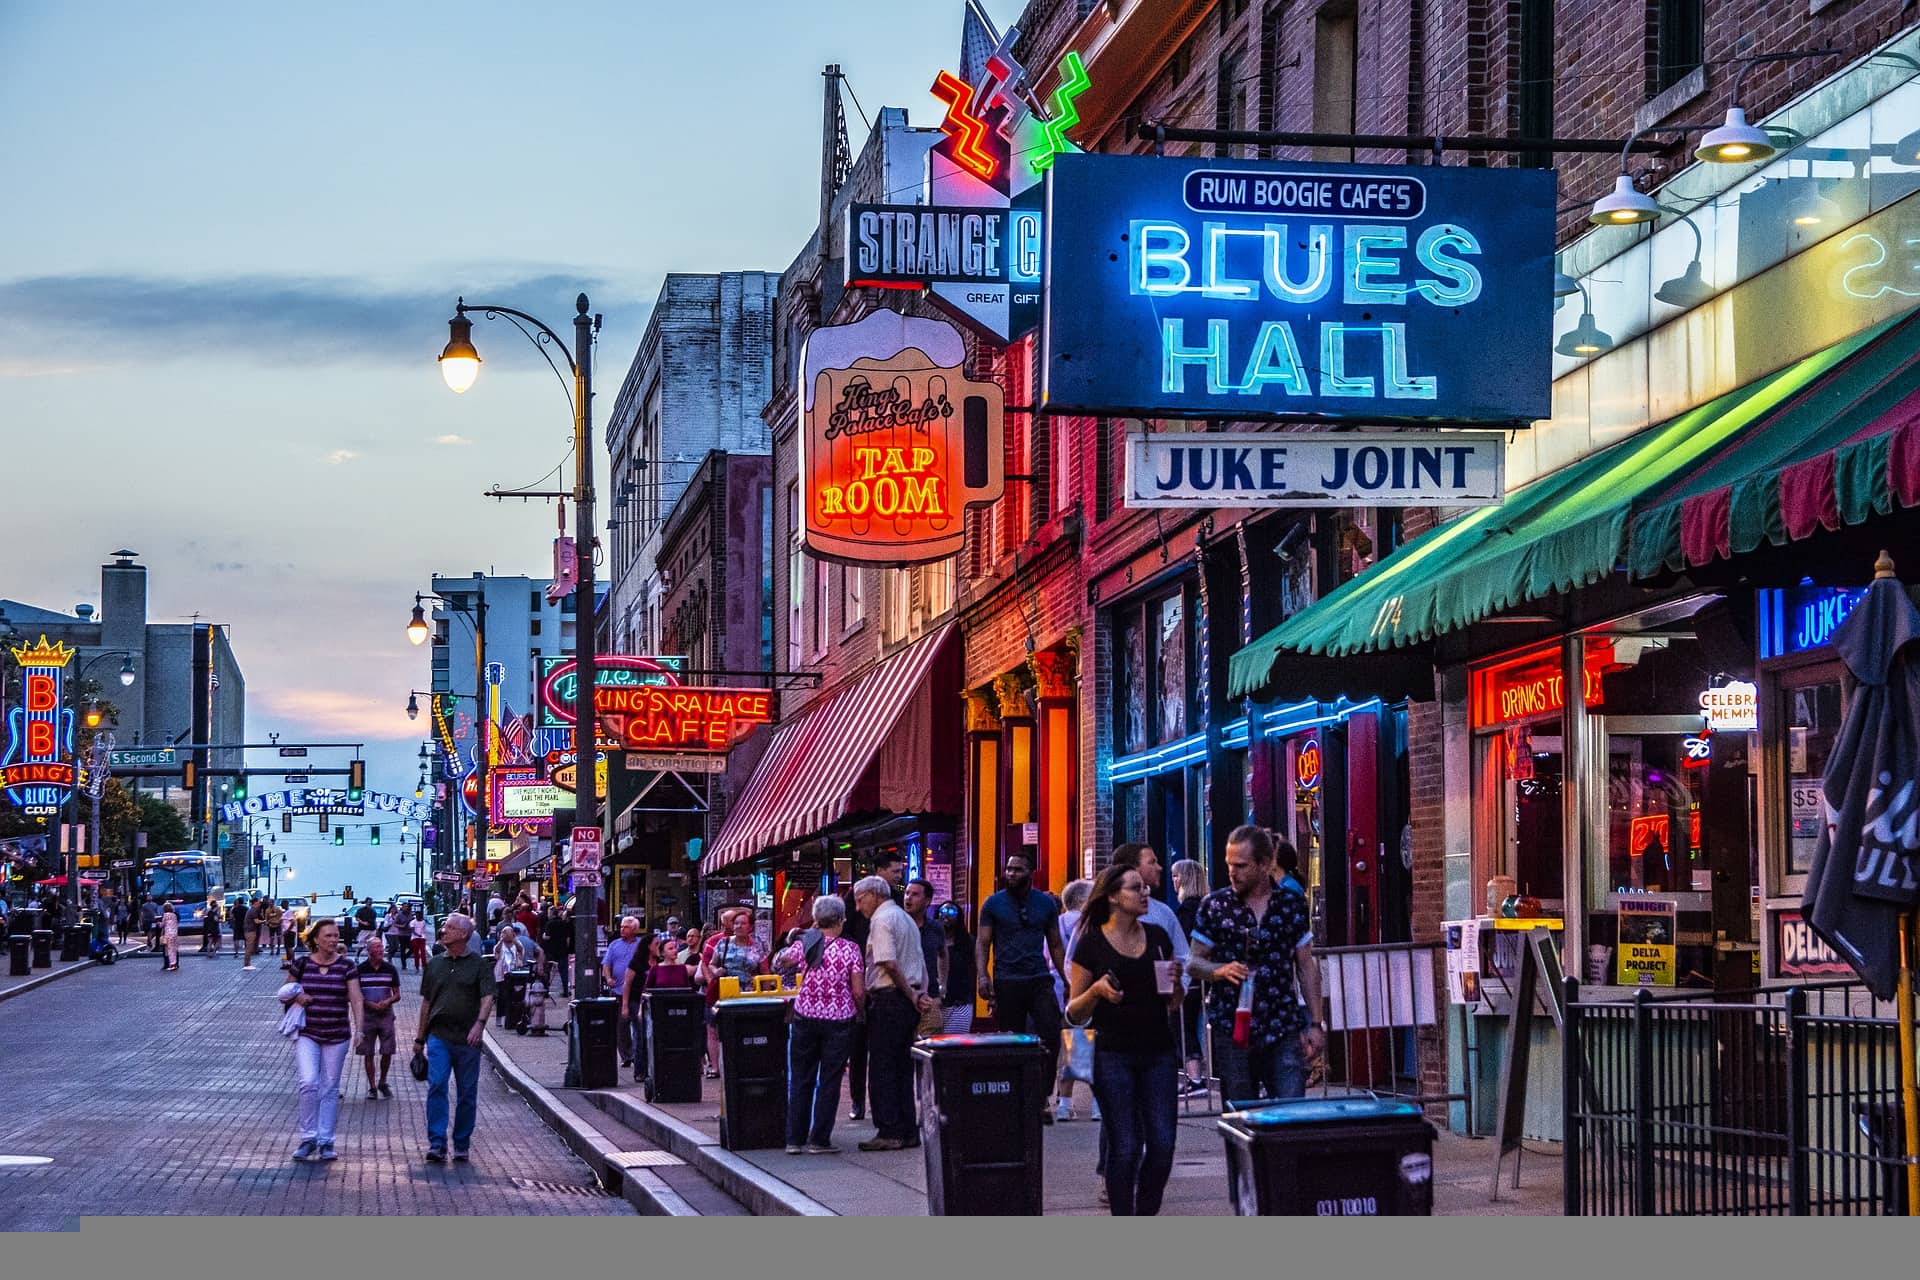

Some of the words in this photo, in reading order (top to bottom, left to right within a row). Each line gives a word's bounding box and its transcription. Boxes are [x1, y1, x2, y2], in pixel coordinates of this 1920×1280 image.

[1199, 177, 1246, 205] RUM
[1254, 179, 1332, 208] BOOGIE
[1340, 182, 1410, 210] CAFE'S
[858, 211, 1000, 277] STRANGE
[1129, 218, 1482, 307] BLUES
[966, 293, 1005, 304] GREAT
[1162, 318, 1438, 400] HALL
[825, 411, 894, 440] Palace
[892, 394, 954, 436] Cafe's
[855, 447, 936, 480] TAP
[1156, 447, 1288, 491] JUKE
[1321, 446, 1475, 490] JOINT
[821, 476, 945, 515] ROOM
[674, 693, 767, 717] PALACE
[1502, 681, 1546, 718] DRINKS
[629, 720, 728, 743] CAFE
[123, 753, 156, 763] Second
[25, 787, 57, 804] BLUES
[223, 789, 305, 821] HOME
[316, 788, 331, 796] OF
[346, 789, 429, 820] LUES
[312, 796, 335, 805] THE
[1793, 789, 1818, 808] $5
[25, 806, 57, 815] CLUB
[297, 806, 325, 814] BEALE
[327, 806, 359, 814] STREET
[578, 830, 595, 840] NO
[1620, 901, 1673, 912] TONIGHT
[1632, 947, 1660, 958] DELTA
[1626, 960, 1667, 971] PROJECT
